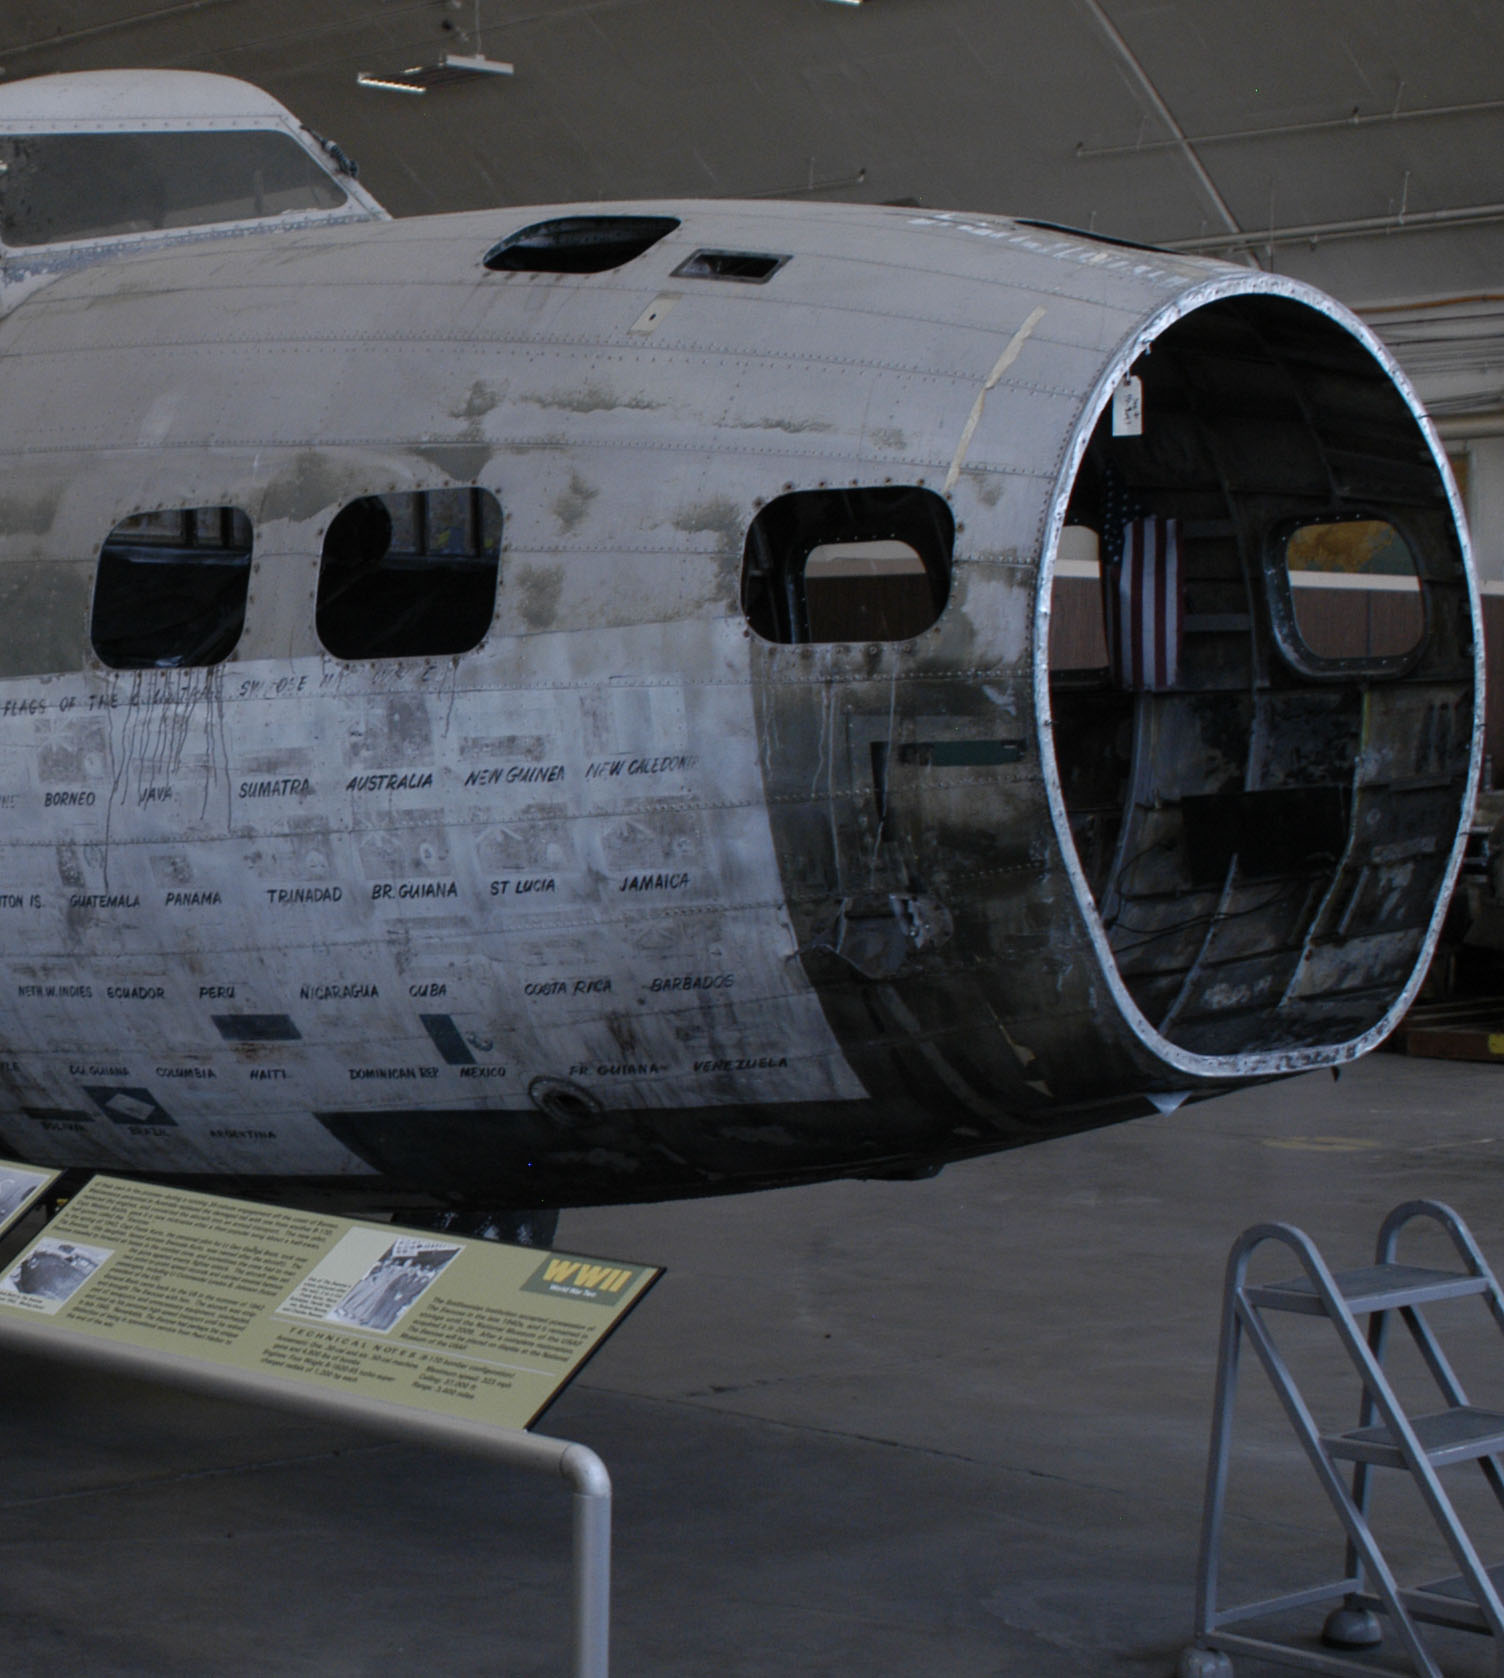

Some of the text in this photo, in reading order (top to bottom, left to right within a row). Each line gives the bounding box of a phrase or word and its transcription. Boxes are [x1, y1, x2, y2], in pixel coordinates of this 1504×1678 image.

[2, 700, 47, 717] FLAGS
[59, 695, 78, 712] OF
[464, 764, 566, 788] NEW GUINEA
[585, 760, 625, 778] NEW
[238, 777, 311, 799] SUMATRA
[345, 772, 434, 792] AUSTRALIA
[44, 791, 96, 809] BORNEO
[141, 787, 173, 804] JAVA
[398, 880, 459, 899] GUIANA
[490, 877, 557, 897] ST LUCIA
[618, 871, 691, 893] JAMAICA
[69, 893, 142, 909] GUATEMALA
[164, 891, 224, 907] PANAMA
[266, 885, 344, 905] TRINADAD
[106, 985, 166, 1000] ECUADOR
[199, 984, 236, 1000] PERU
[299, 983, 380, 1001] NICARAGUA
[408, 982, 448, 999] CUBA
[524, 976, 612, 996] COSTA RICA
[647, 973, 736, 994] BARBADOS
[155, 1066, 218, 1080] COLUMBIA
[348, 1066, 417, 1081] DOMINICAN
[459, 1066, 508, 1080] MEXICO
[596, 1063, 660, 1078] GUIANA
[692, 1055, 790, 1074] VENEZUELA
[249, 1067, 288, 1081] HAITI
[542, 1258, 633, 1293] WWII
[289, 1326, 368, 1349] TECHNICAL
